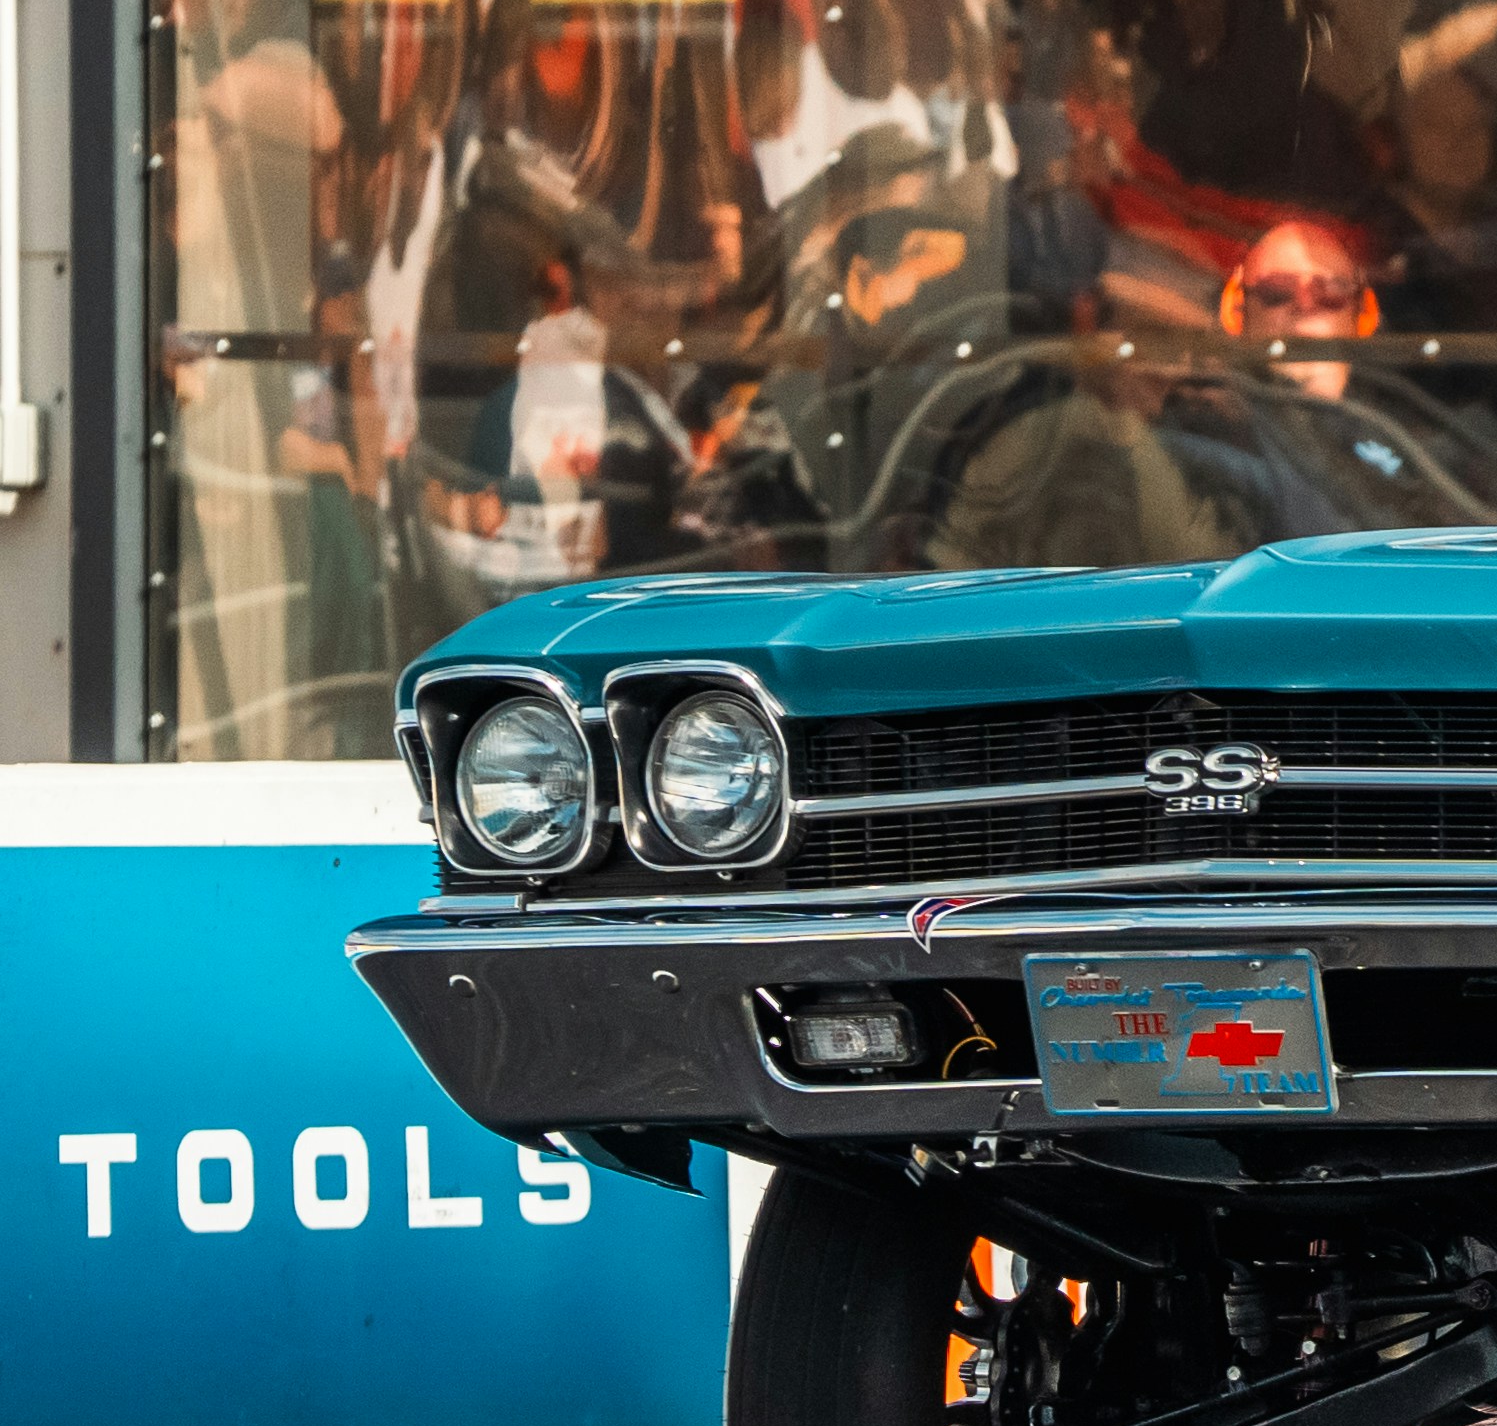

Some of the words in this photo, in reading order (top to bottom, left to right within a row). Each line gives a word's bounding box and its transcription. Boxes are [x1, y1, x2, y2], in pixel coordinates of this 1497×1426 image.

[1145, 743, 1269, 796] SS
[1165, 794, 1248, 816] 396
[1066, 975, 1099, 992] BUILT
[1101, 977, 1121, 992] BY
[1112, 1011, 1170, 1036] THE
[1049, 1040, 1169, 1063] NUMBER
[1242, 1071, 1321, 1094] TEAM
[59, 1126, 592, 1237] TOOLS
